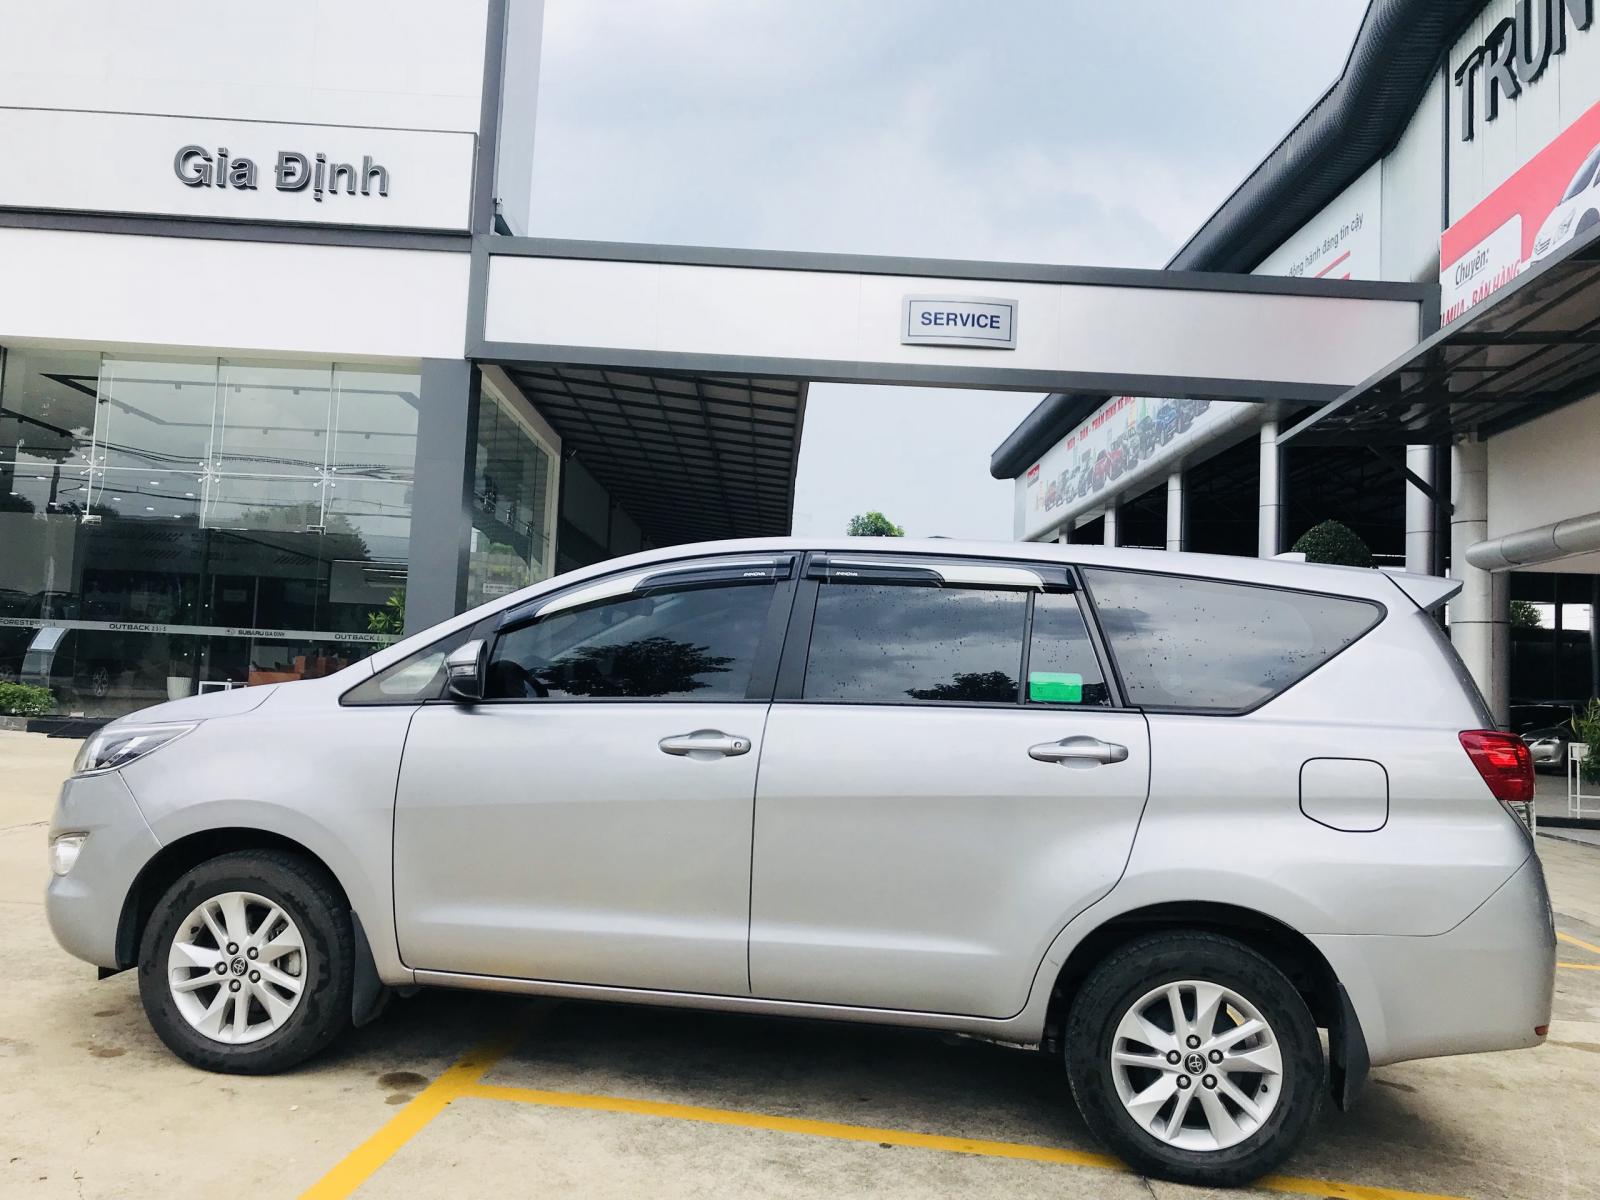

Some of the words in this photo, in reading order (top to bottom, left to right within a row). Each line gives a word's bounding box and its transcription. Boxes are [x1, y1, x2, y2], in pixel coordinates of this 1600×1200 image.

[173, 145, 258, 190] Gia
[274, 150, 389, 202] Định
[1340, 224, 1349, 241] tin
[1350, 211, 1364, 232] cậy
[1455, 248, 1490, 286] Chuyên:
[921, 311, 1001, 330] SERVICE
[109, 623, 150, 631] OUTBACK
[334, 633, 375, 641] OUTBACK
